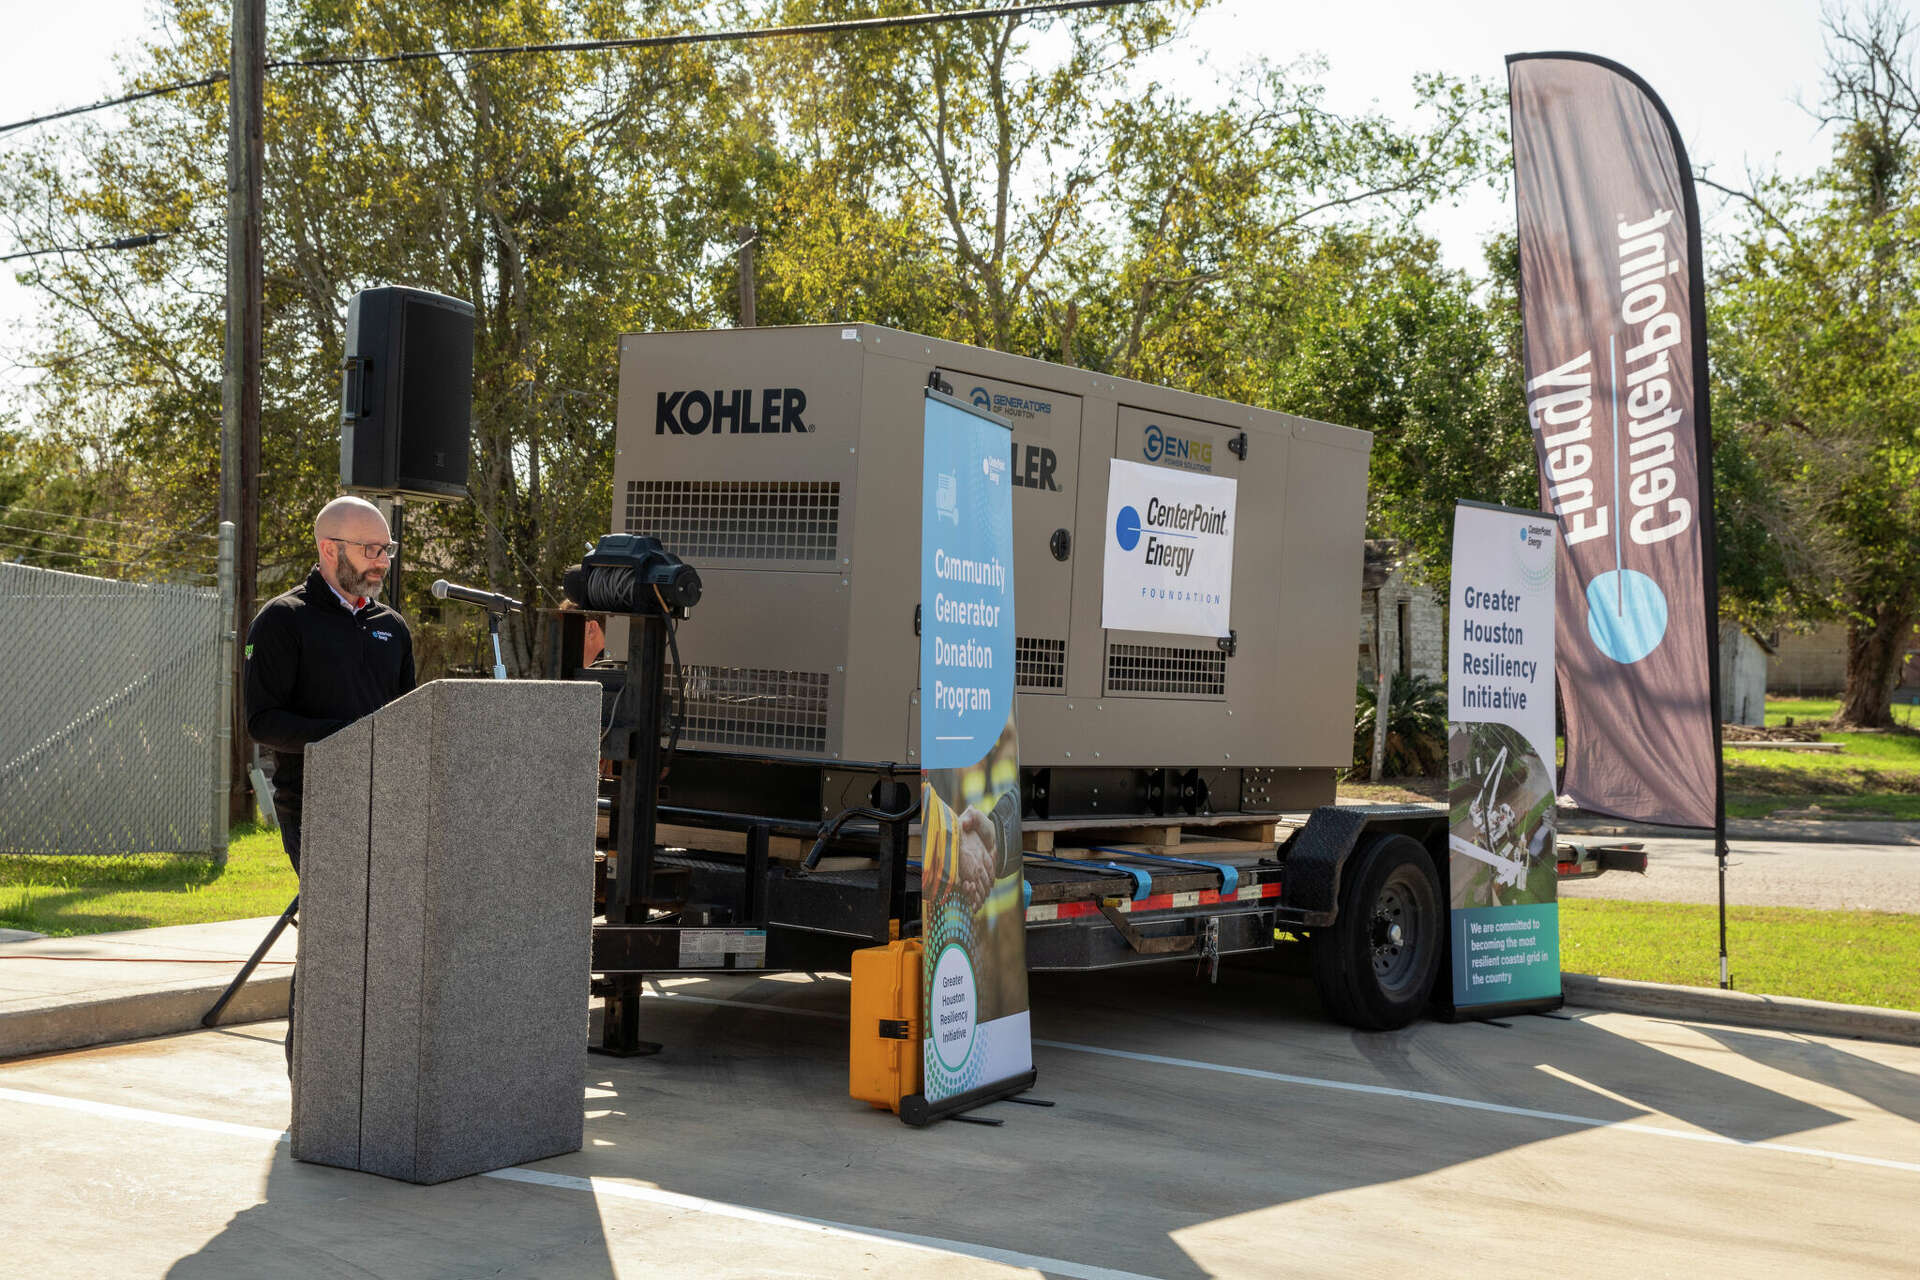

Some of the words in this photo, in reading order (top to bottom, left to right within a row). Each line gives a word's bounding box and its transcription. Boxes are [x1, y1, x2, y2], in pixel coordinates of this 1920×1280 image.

[993, 394, 1052, 415] GENERATORS
[1004, 407, 1036, 419] HOUSTON
[1011, 442, 1058, 492] LER
[1146, 497, 1227, 536] CenterPoint
[1144, 536, 1195, 577] Energy
[935, 549, 1005, 595] Community
[1142, 586, 1221, 605] FOUNDATION
[1464, 586, 1521, 612] Greater
[935, 592, 1001, 628] Generator
[1463, 619, 1523, 645] Houston
[935, 636, 993, 669] Donation
[1463, 652, 1537, 684] Resiliency
[935, 680, 991, 718] Program
[1462, 684, 1527, 711] Initiative
[1470, 922, 1482, 934] We
[1483, 923, 1495, 933] are
[1495, 919, 1532, 932] committed
[1532, 919, 1541, 929] to
[1471, 938, 1505, 951] becoming
[1506, 937, 1518, 947] the
[1519, 936, 1537, 947] most
[1471, 955, 1500, 968] resilient
[1501, 952, 1526, 965] coastal
[1526, 951, 1541, 966] grid
[1541, 951, 1549, 962] in
[942, 975, 964, 988] Greater
[1472, 972, 1485, 985] the
[1485, 972, 1512, 985] country
[942, 992, 966, 1007] Houston
[940, 1010, 969, 1026] Resiliency
[942, 1027, 968, 1043] Initiative
